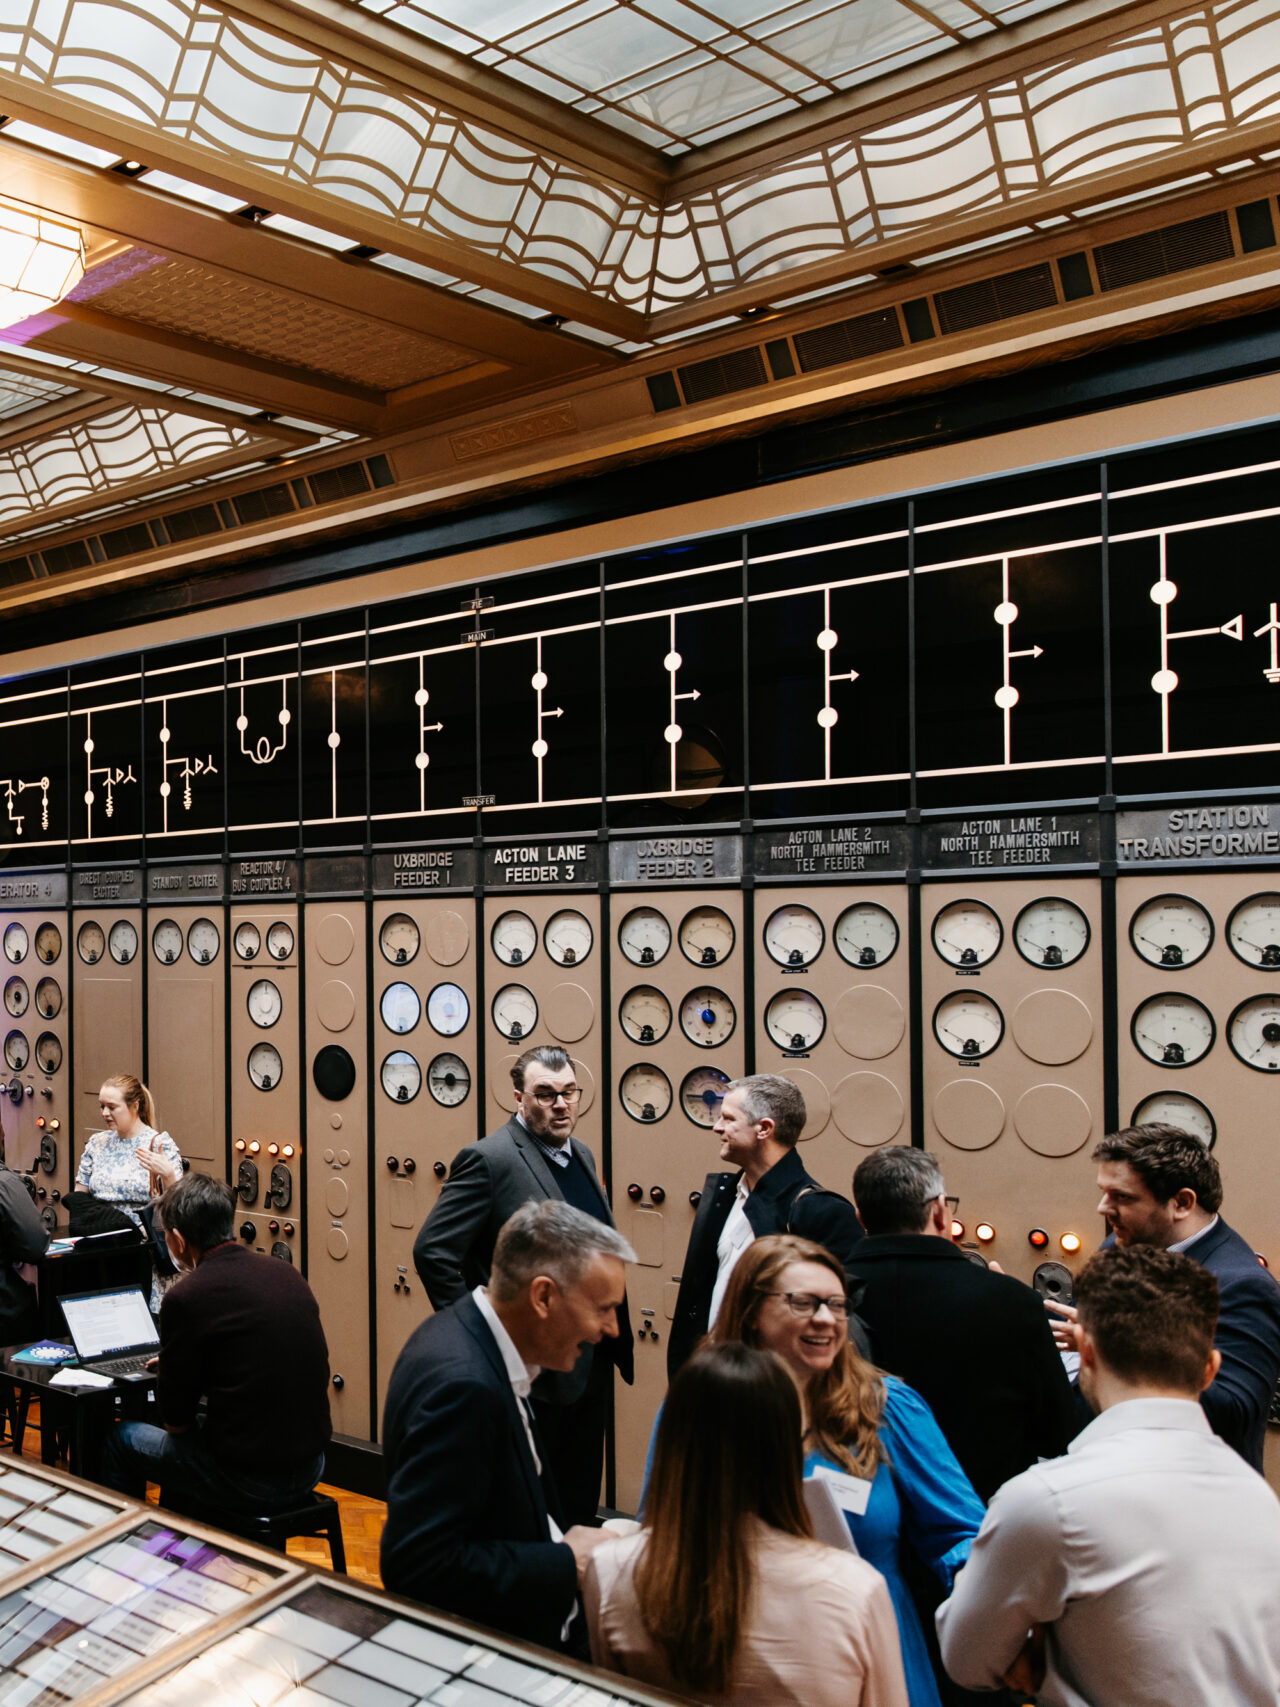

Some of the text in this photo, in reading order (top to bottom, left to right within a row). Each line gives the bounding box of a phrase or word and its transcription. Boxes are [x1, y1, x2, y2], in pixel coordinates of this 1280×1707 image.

[468, 632, 487, 642] MAIN
[961, 816, 1058, 836] ACTON LANE 1
[1169, 805, 1270, 832] STATION
[788, 827, 873, 845] ACTON LANE 2
[940, 831, 1080, 852] NORTH HAMMERSMITH
[493, 845, 587, 864] ACTON LANE
[637, 838, 714, 858] UXBRIDGE
[770, 840, 891, 860] NORTH HAMMERSMITH
[1119, 832, 1280, 859] TRANSFORME
[393, 852, 454, 869] UXBRIDGE
[796, 856, 865, 872] TEE FEEDER
[970, 848, 1051, 866] TEE FEEDER
[240, 861, 274, 876] REACTOR
[505, 865, 576, 883] FEEDER 3
[637, 858, 715, 879] FEEDER 2
[188, 873, 219, 888] EXCITER
[232, 876, 291, 892] BUS COUPLER 4
[393, 871, 440, 887] FEEDER
